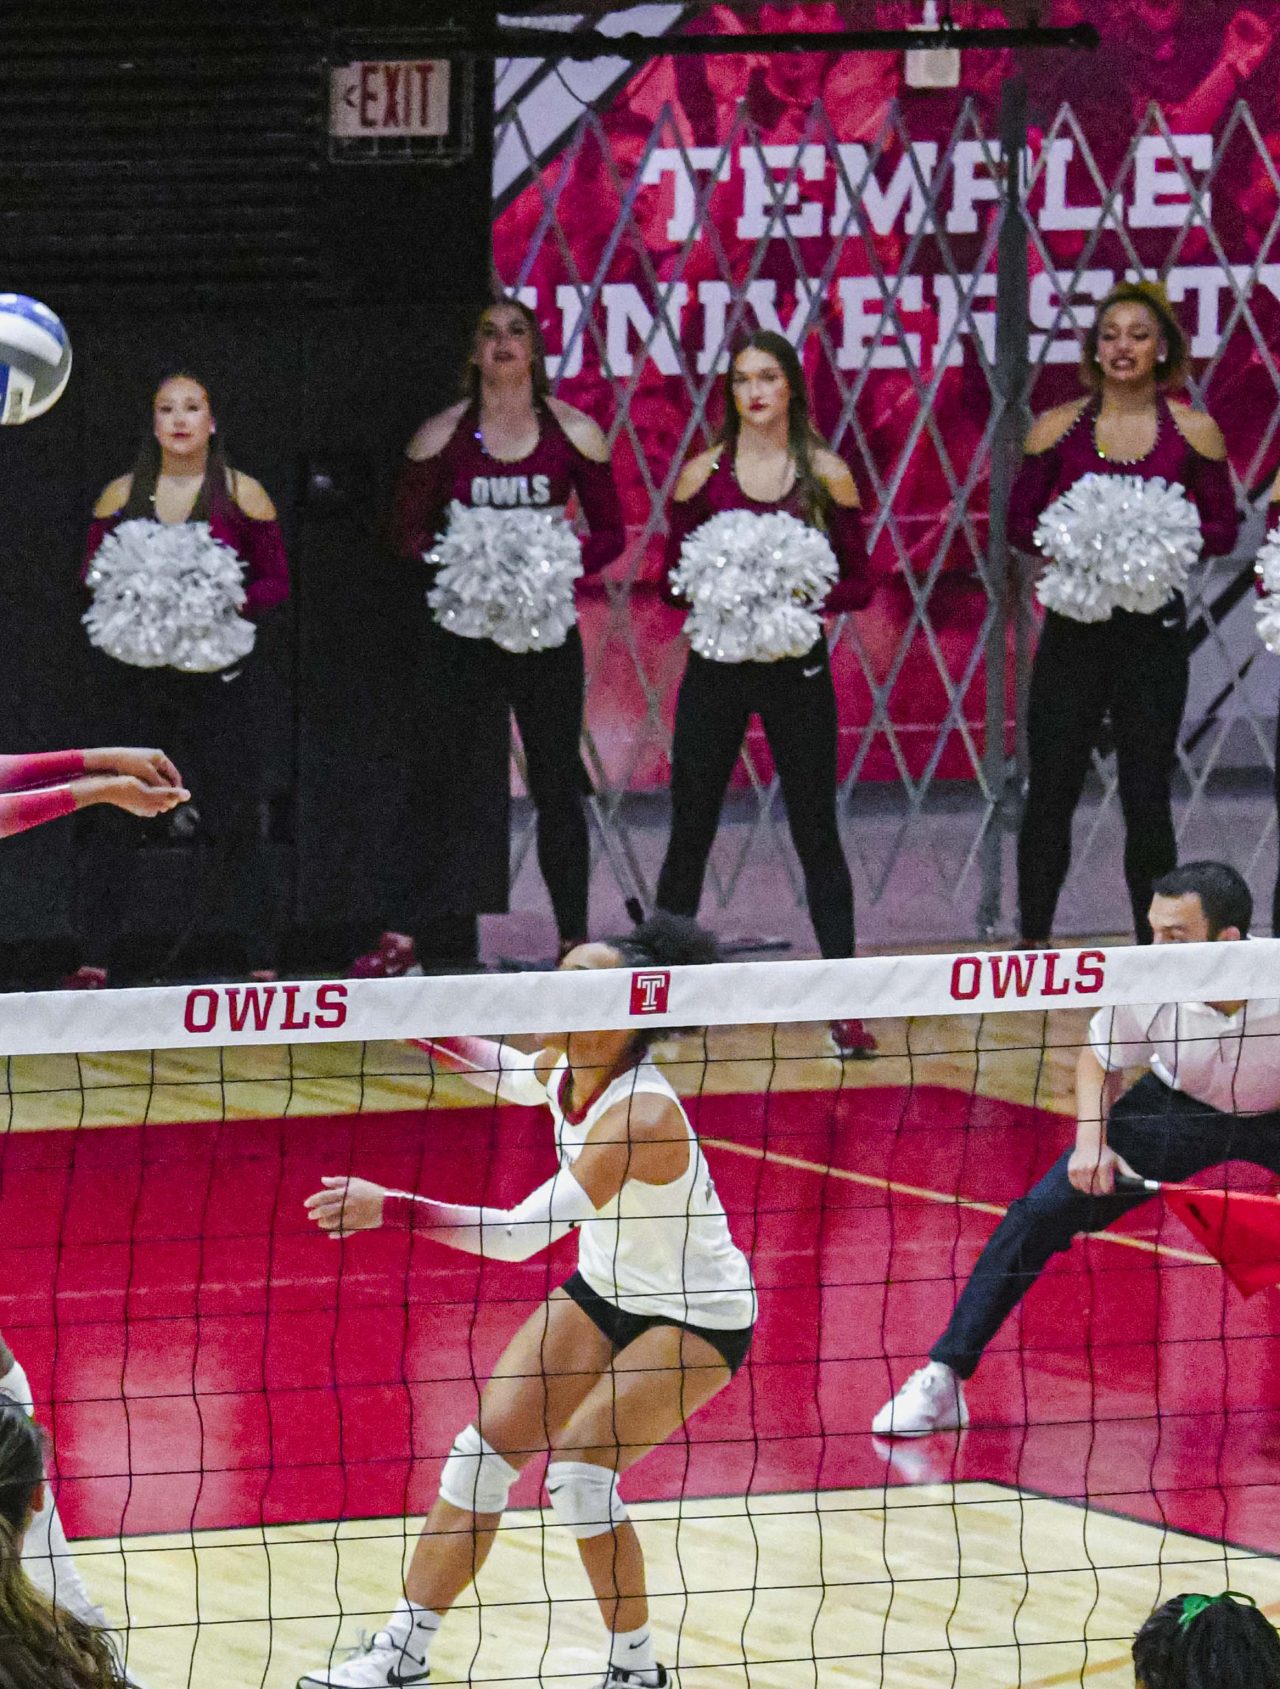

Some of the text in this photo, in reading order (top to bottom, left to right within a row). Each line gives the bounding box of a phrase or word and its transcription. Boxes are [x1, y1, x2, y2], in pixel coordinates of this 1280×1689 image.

[360, 63, 434, 127] EXIT
[640, 134, 1213, 241] TEMPLE
[471, 474, 551, 505] OWLS
[637, 975, 665, 1011] T
[950, 952, 1106, 1000] OWLS
[183, 983, 348, 1033] OWLS
